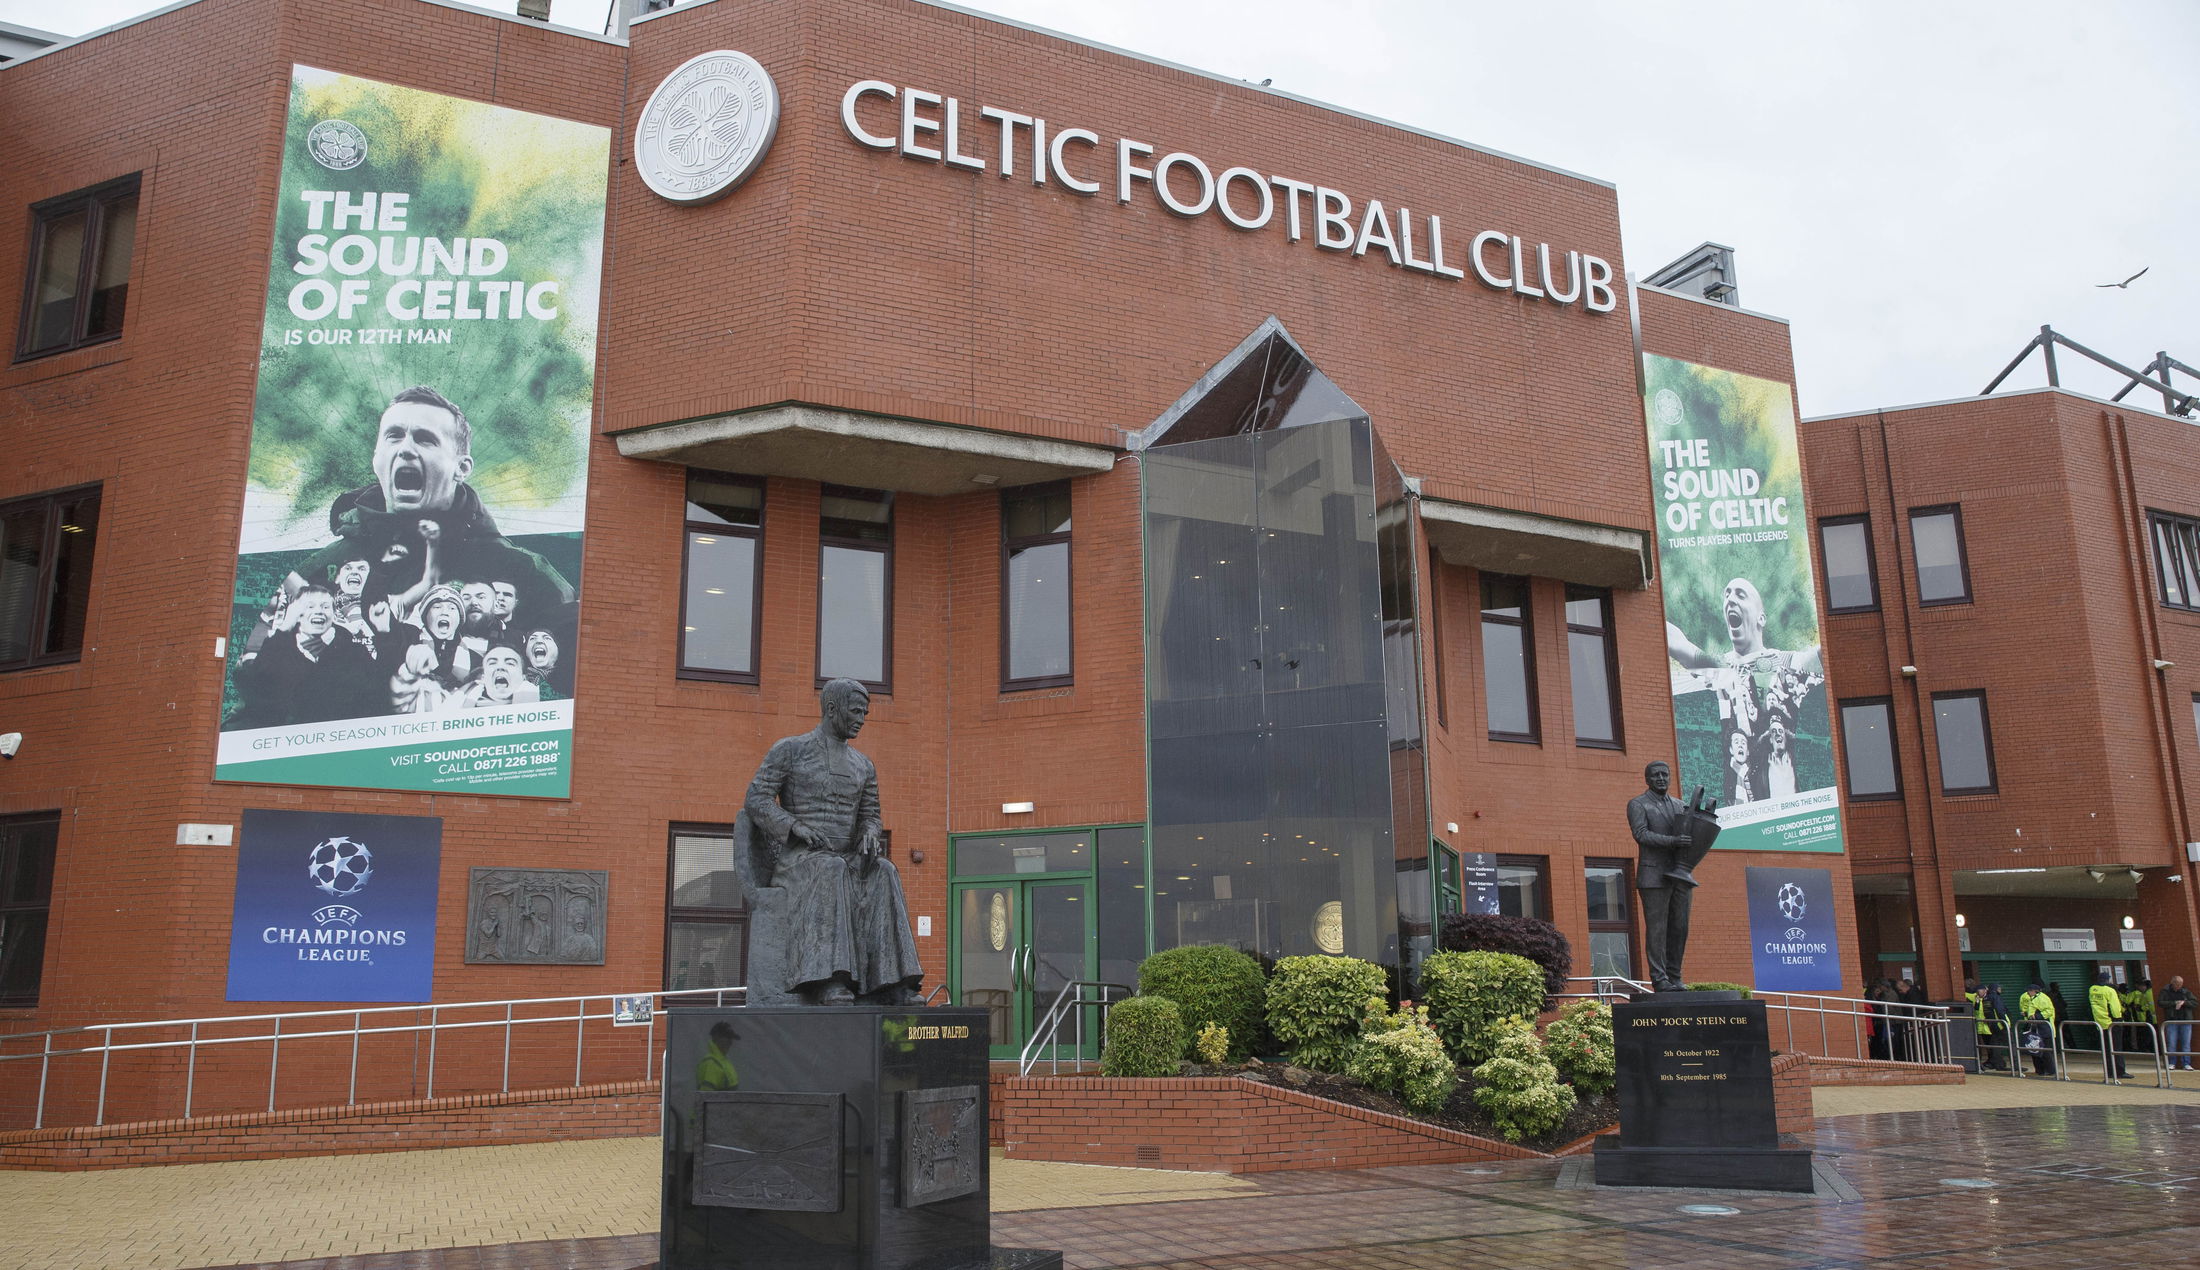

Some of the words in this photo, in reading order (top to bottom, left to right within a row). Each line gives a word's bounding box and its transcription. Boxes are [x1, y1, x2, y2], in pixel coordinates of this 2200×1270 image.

[645, 116, 660, 142] THE
[656, 76, 690, 111] CELTIC
[695, 61, 750, 83] FOOTBALL
[748, 79, 764, 111] CLUB
[688, 174, 716, 191] 1888
[840, 80, 1099, 195] CELTIC
[1117, 138, 1464, 281] FOOTBALL
[1468, 230, 1616, 314] CLUB
[301, 190, 410, 231] THE
[293, 234, 509, 276] SOUND
[288, 279, 370, 321] OF
[385, 280, 559, 320] CELTIC
[284, 329, 303, 346] IS
[308, 329, 352, 346] OUR
[357, 329, 402, 345] 12TH
[407, 329, 452, 344] MAN
[1659, 439, 1710, 468] THE
[1664, 468, 1760, 500] SOUND
[1666, 502, 1701, 532] OF
[1709, 497, 1788, 530] CELTIC
[1668, 537, 1696, 549] TURNS
[1697, 534, 1732, 546] PLAYERS
[1733, 532, 1752, 544] INTO
[1752, 530, 1788, 542] LEGENDS
[252, 736, 281, 750] GET
[286, 732, 325, 746] YOUR
[329, 726, 387, 742] SEASON
[391, 721, 438, 736] TICKET.
[443, 717, 485, 731] BRING
[488, 714, 513, 725] THE
[517, 710, 560, 723] NOISE.
[390, 753, 421, 767] VISIT
[424, 740, 559, 763] SOUNDOFCELTIC.COM
[439, 763, 470, 775] CALL
[473, 760, 502, 771] 0871
[505, 756, 527, 768] 226
[1732, 807, 1757, 820] SEASON
[1780, 799, 1800, 810] BRING
[1800, 797, 1812, 807] THE
[1761, 826, 1775, 835] VISIT
[1776, 814, 1835, 833] SOUNDOFCELTIC.COM
[1784, 831, 1798, 840] CALL
[1812, 826, 1822, 834] 226
[314, 908, 358, 924] UEFA
[263, 927, 406, 945] CHAMPIONS
[1785, 929, 1806, 940] UEFA
[298, 949, 370, 961] LEAGUE
[1765, 942, 1827, 954] CHAMPIONS
[1782, 956, 1813, 964] LEAGUE
[1632, 1018, 1657, 1027] JOHN
[1660, 1017, 1693, 1026] "JOCK"
[1696, 1016, 1726, 1025] STEIN
[1729, 1017, 1748, 1025] CBE
[908, 1026, 940, 1040] BROTHER
[941, 1025, 969, 1039] WALFRID
[1676, 1049, 1702, 1057] October
[1676, 1073, 1710, 1082] September
[1713, 1073, 1727, 1081] 1985
